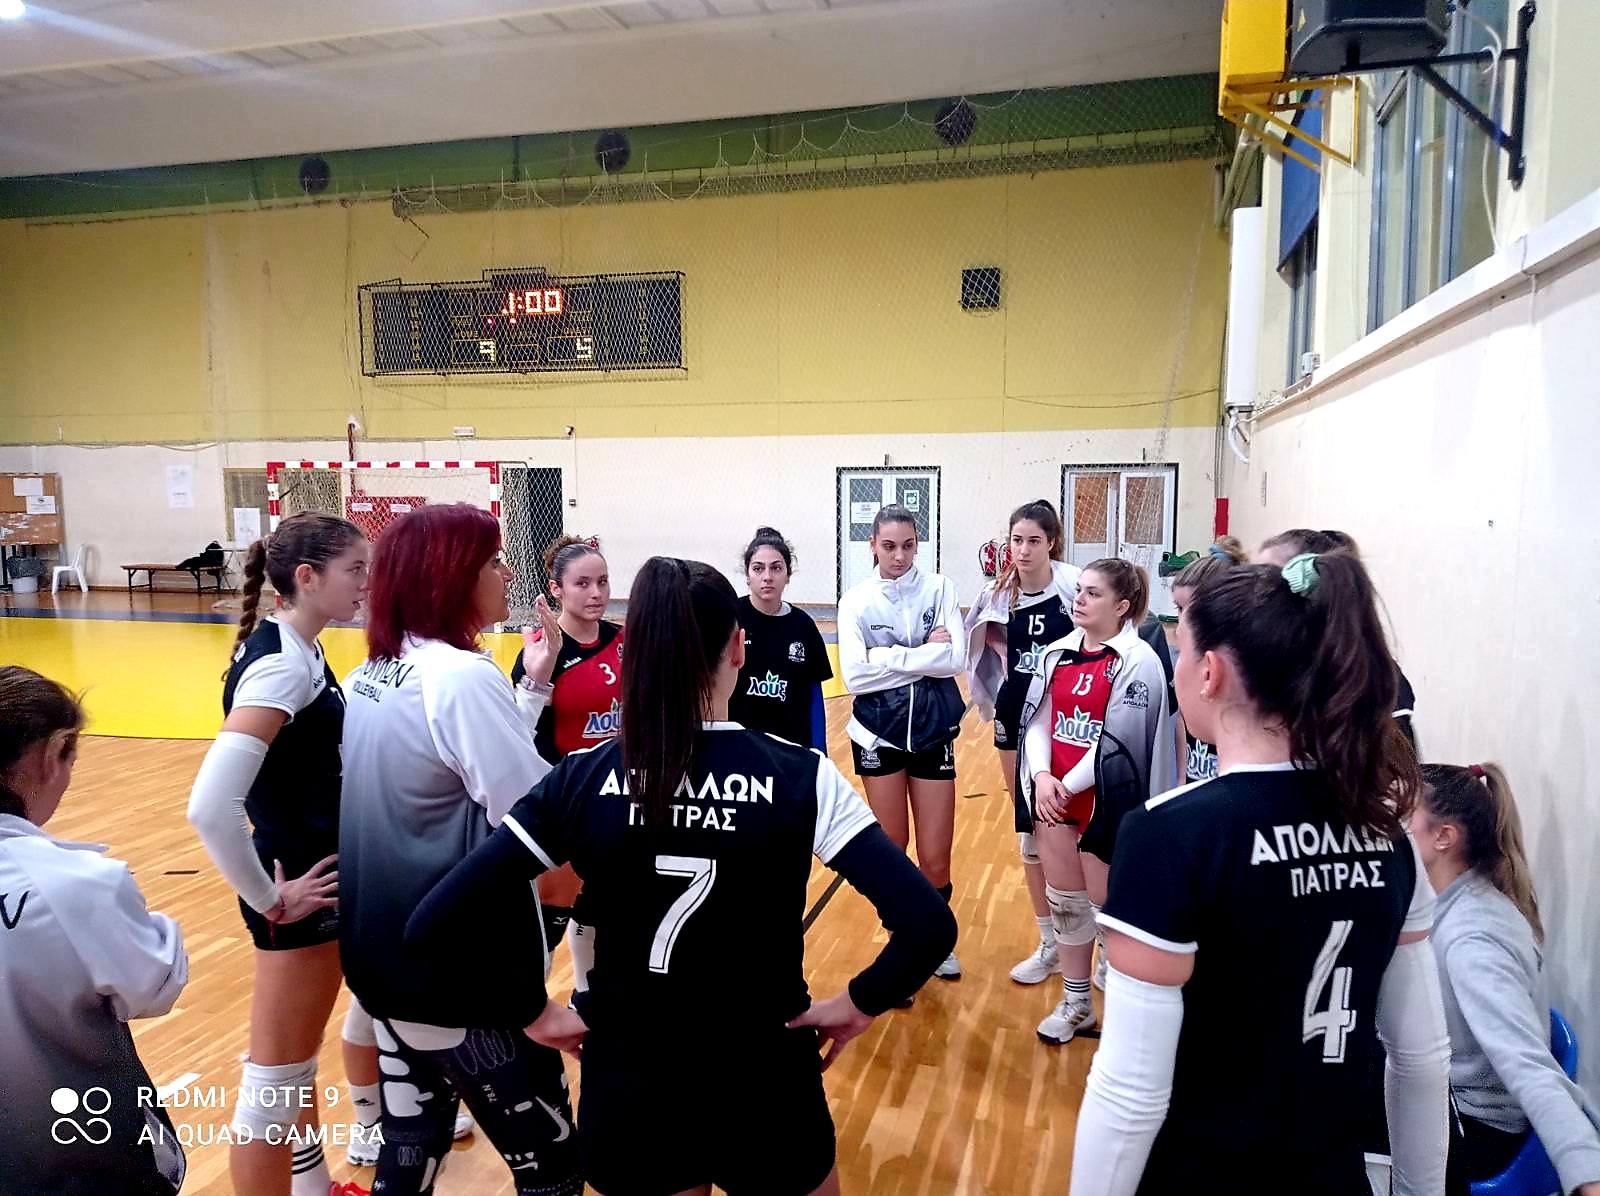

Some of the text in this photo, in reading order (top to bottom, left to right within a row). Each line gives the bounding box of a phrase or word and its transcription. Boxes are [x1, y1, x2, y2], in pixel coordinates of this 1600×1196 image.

[479, 340, 495, 361] 9
[576, 337, 592, 359] 5
[1028, 614, 1046, 636] 15
[599, 663, 617, 685] 3
[1071, 672, 1094, 696] 13
[628, 802, 737, 831] ΠΤΡΑΣ
[1290, 860, 1386, 897] ΠΑΤΡΑΣ
[648, 855, 717, 974] 7
[1302, 919, 1358, 1064] 4
